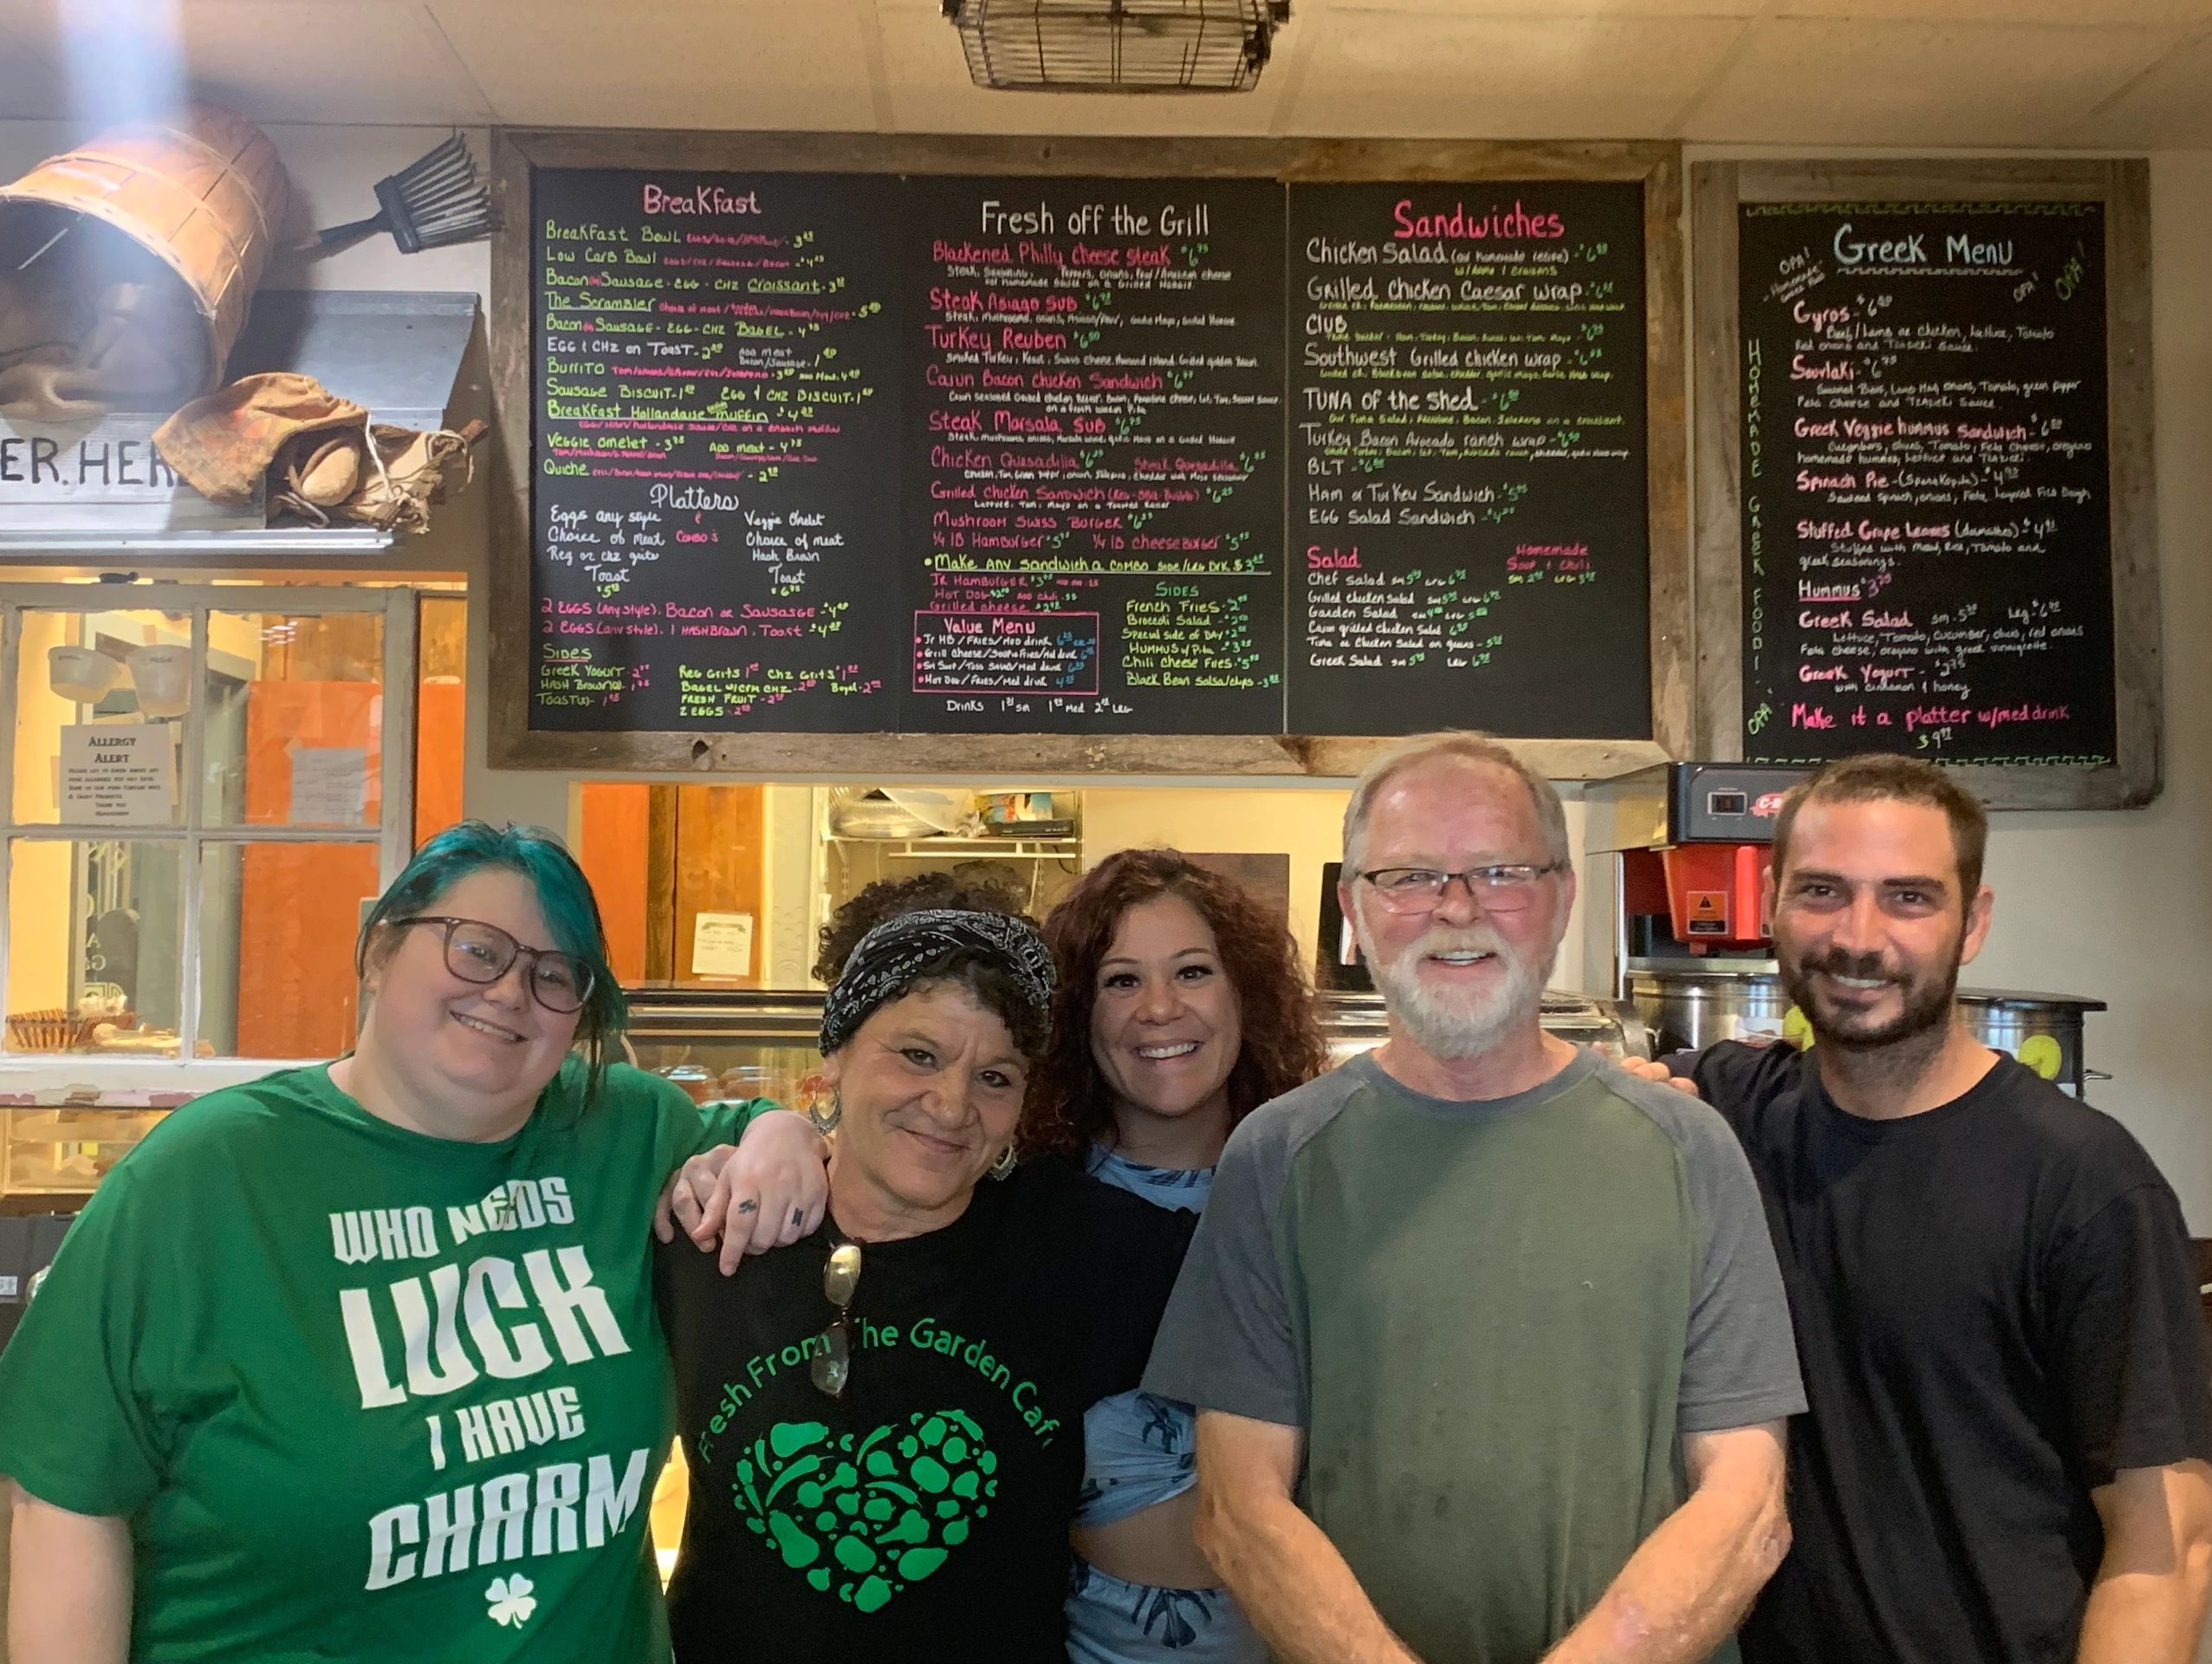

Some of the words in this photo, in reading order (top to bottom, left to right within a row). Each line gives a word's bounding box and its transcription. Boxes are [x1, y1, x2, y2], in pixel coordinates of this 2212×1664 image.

[982, 201, 1054, 236] Fresh
[1068, 204, 1104, 234] off
[1111, 206, 1151, 236] the
[1160, 204, 1209, 236] Grill
[1394, 199, 1565, 238] Sandwiches
[1383, 241, 1448, 263] Salad
[545, 291, 574, 309] The
[1794, 301, 1850, 332] Gyros
[1304, 342, 1398, 366] Southwest
[1387, 387, 1420, 409] the
[1308, 459, 1342, 475] BLT
[649, 484, 739, 510] Platters
[1307, 545, 1361, 569] Salad
[586, 566, 630, 582] Toast
[769, 565, 805, 584] Toast
[944, 619, 983, 635] Value
[329, 1207, 439, 1264] WHO
[340, 1245, 632, 1408] LUCK
[746, 1333, 832, 1388] From
[854, 1317, 899, 1349] he
[910, 1317, 1011, 1389] Garden
[1012, 1381, 1061, 1448] Caf
[426, 1415, 446, 1470] I
[456, 1386, 586, 1463] HAVE
[364, 1448, 650, 1591] CHARM
